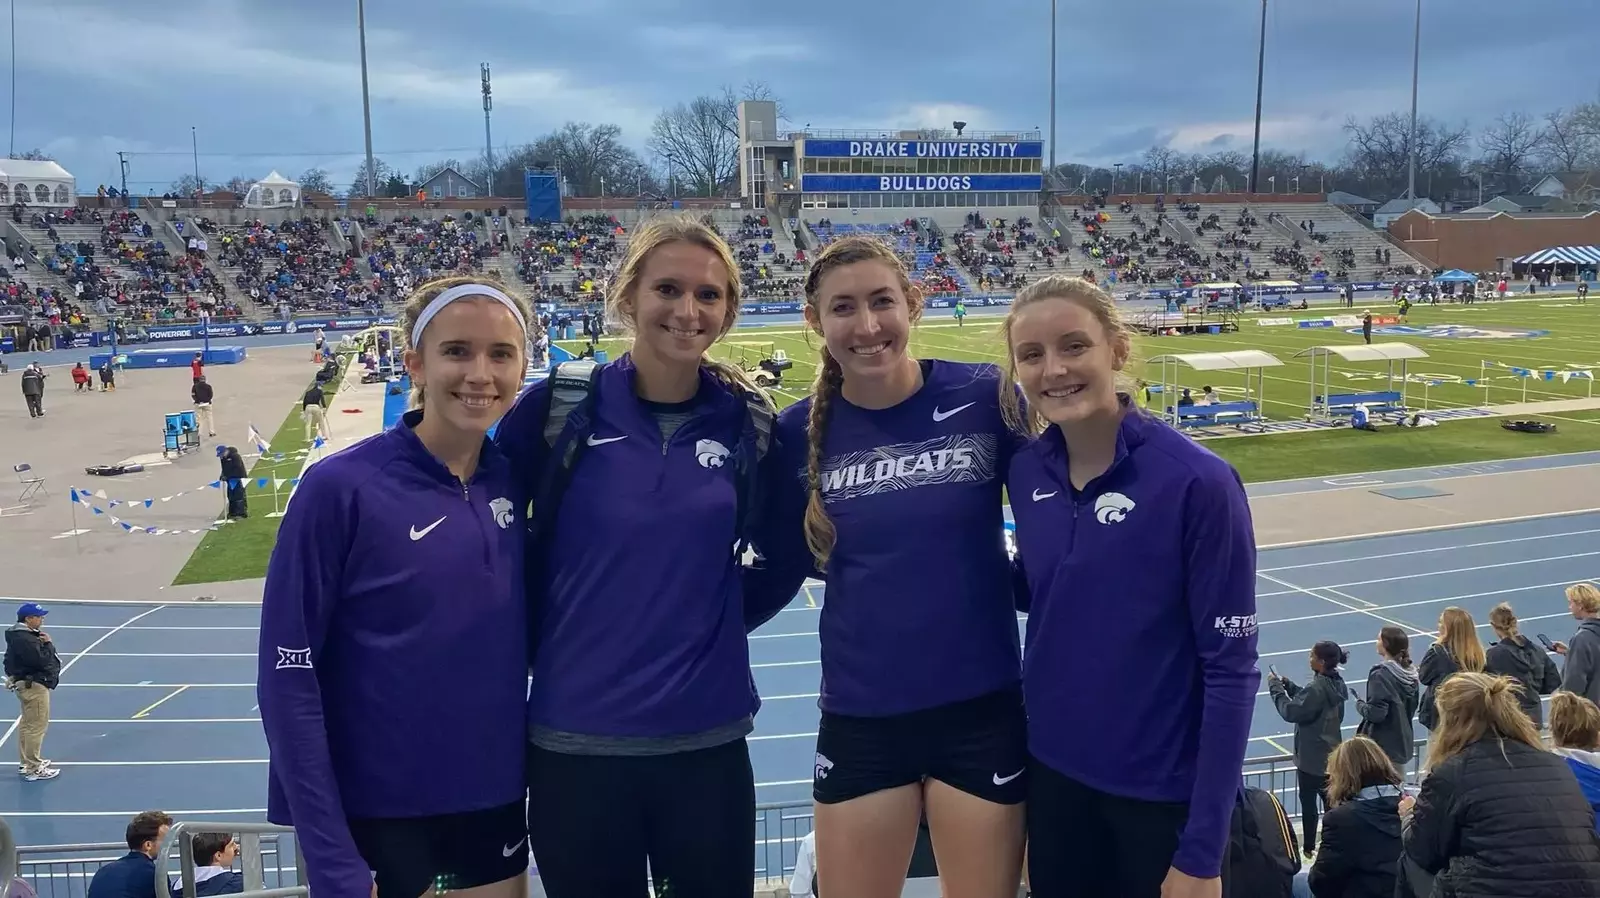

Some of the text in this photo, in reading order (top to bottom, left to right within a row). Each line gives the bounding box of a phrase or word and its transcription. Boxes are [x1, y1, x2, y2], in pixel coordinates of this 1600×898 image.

[849, 141, 1018, 157] DRAKE UNIVERSITY
[880, 175, 971, 191] BULLDOGS
[149, 329, 192, 339] POWERADE
[820, 447, 973, 493] WILDCATS
